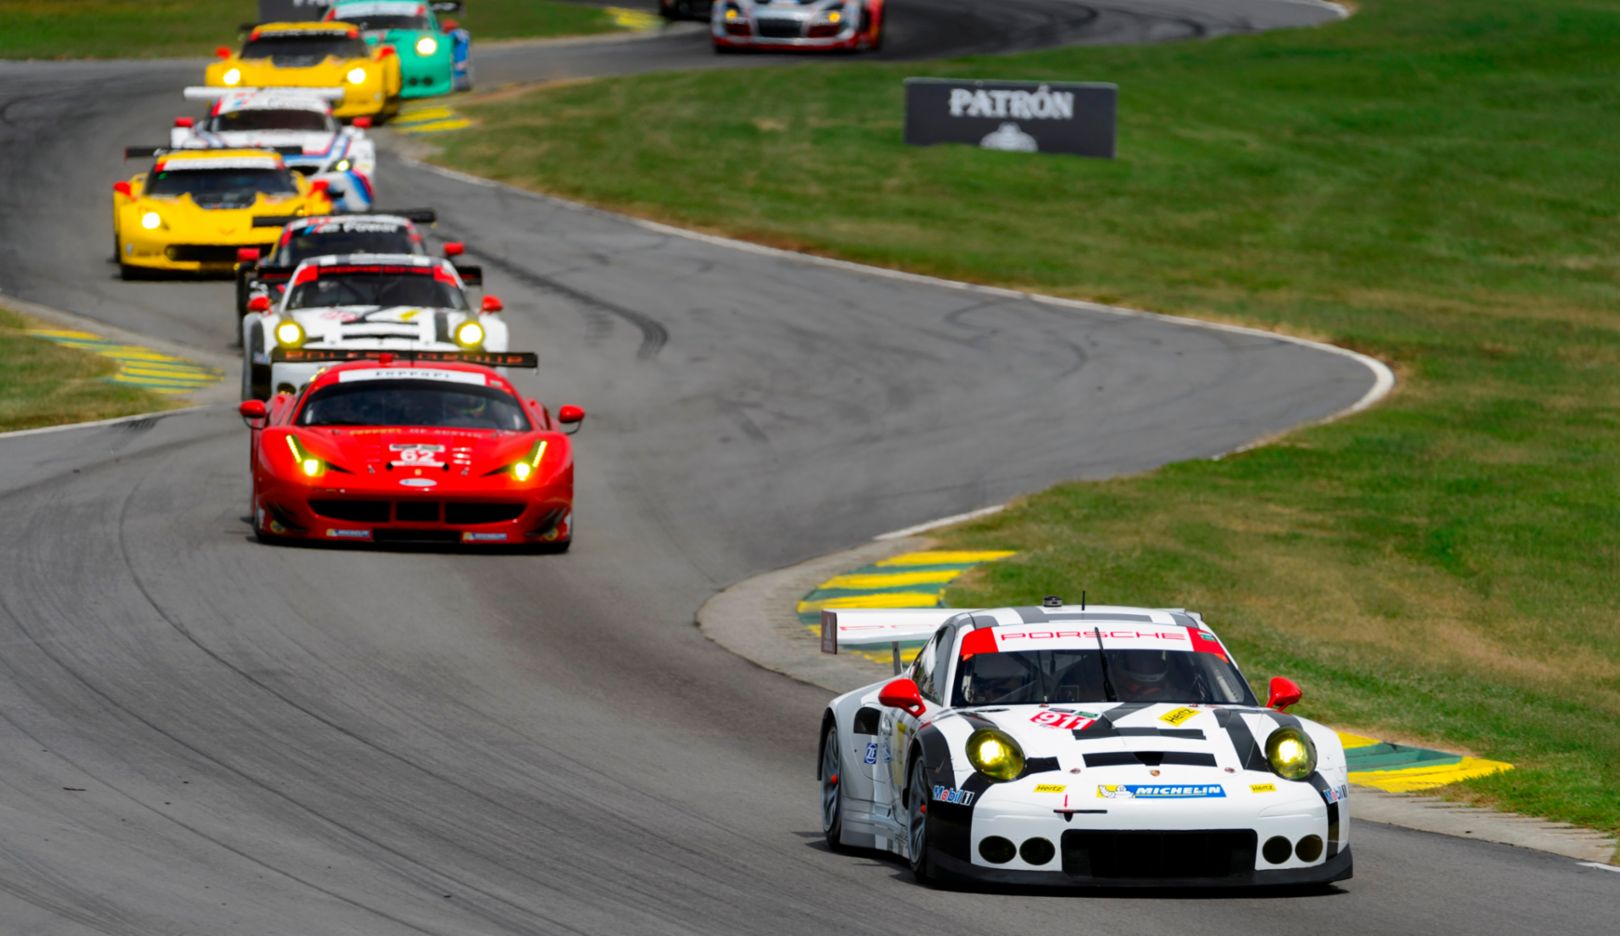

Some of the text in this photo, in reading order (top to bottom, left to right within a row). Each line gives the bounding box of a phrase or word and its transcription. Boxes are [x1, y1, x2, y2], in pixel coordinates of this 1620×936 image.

[949, 84, 1074, 119] PATRÓN
[400, 449, 435, 463] 62
[1000, 630, 1186, 641] PORSCHE
[1033, 711, 1091, 731] 911
[1164, 707, 1195, 724] Hertz
[932, 784, 962, 804] Mobil
[1036, 784, 1063, 792] Hertz
[1135, 786, 1221, 795] MICHELIN
[1251, 784, 1274, 792] Hertz
